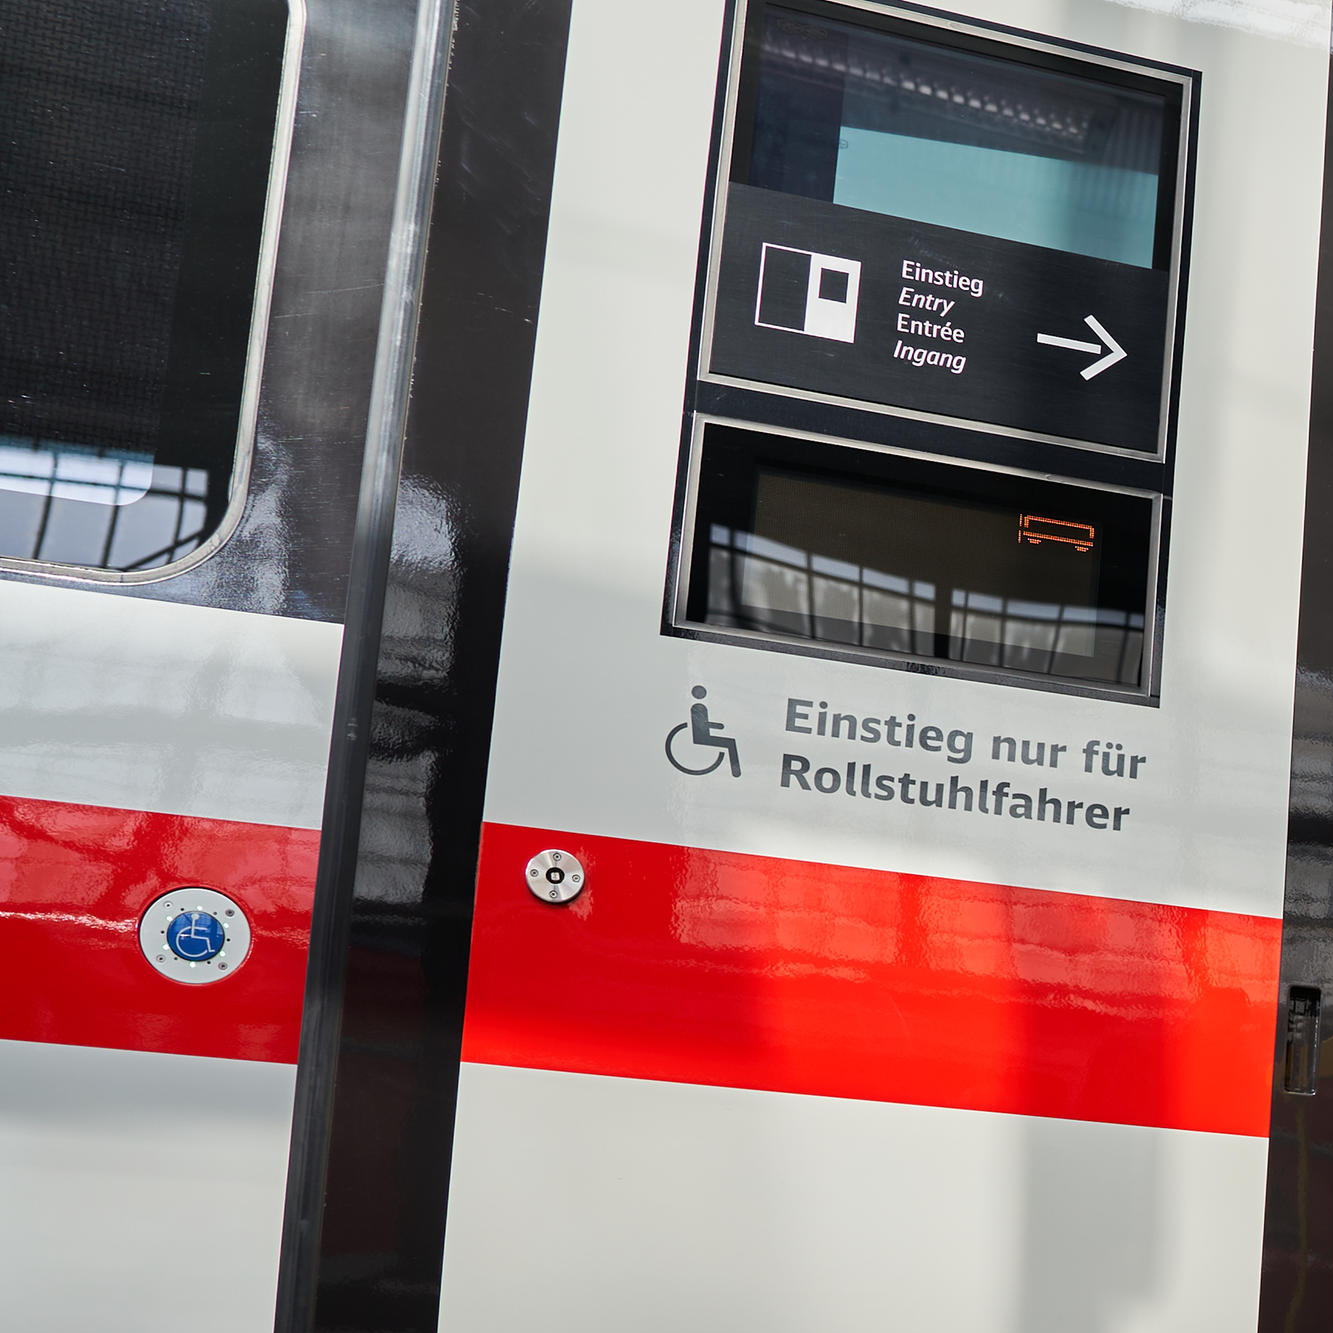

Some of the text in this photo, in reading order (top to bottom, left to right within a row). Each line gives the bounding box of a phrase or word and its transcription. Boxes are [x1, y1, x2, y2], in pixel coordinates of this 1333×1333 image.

[902, 260, 984, 297] Einstieg
[898, 287, 955, 317] Entry
[897, 313, 965, 343] Entrée
[893, 340, 966, 374] Ingang
[785, 697, 1147, 779] Einstieg nur für
[780, 753, 1130, 831] Rollstuhlfahrer
